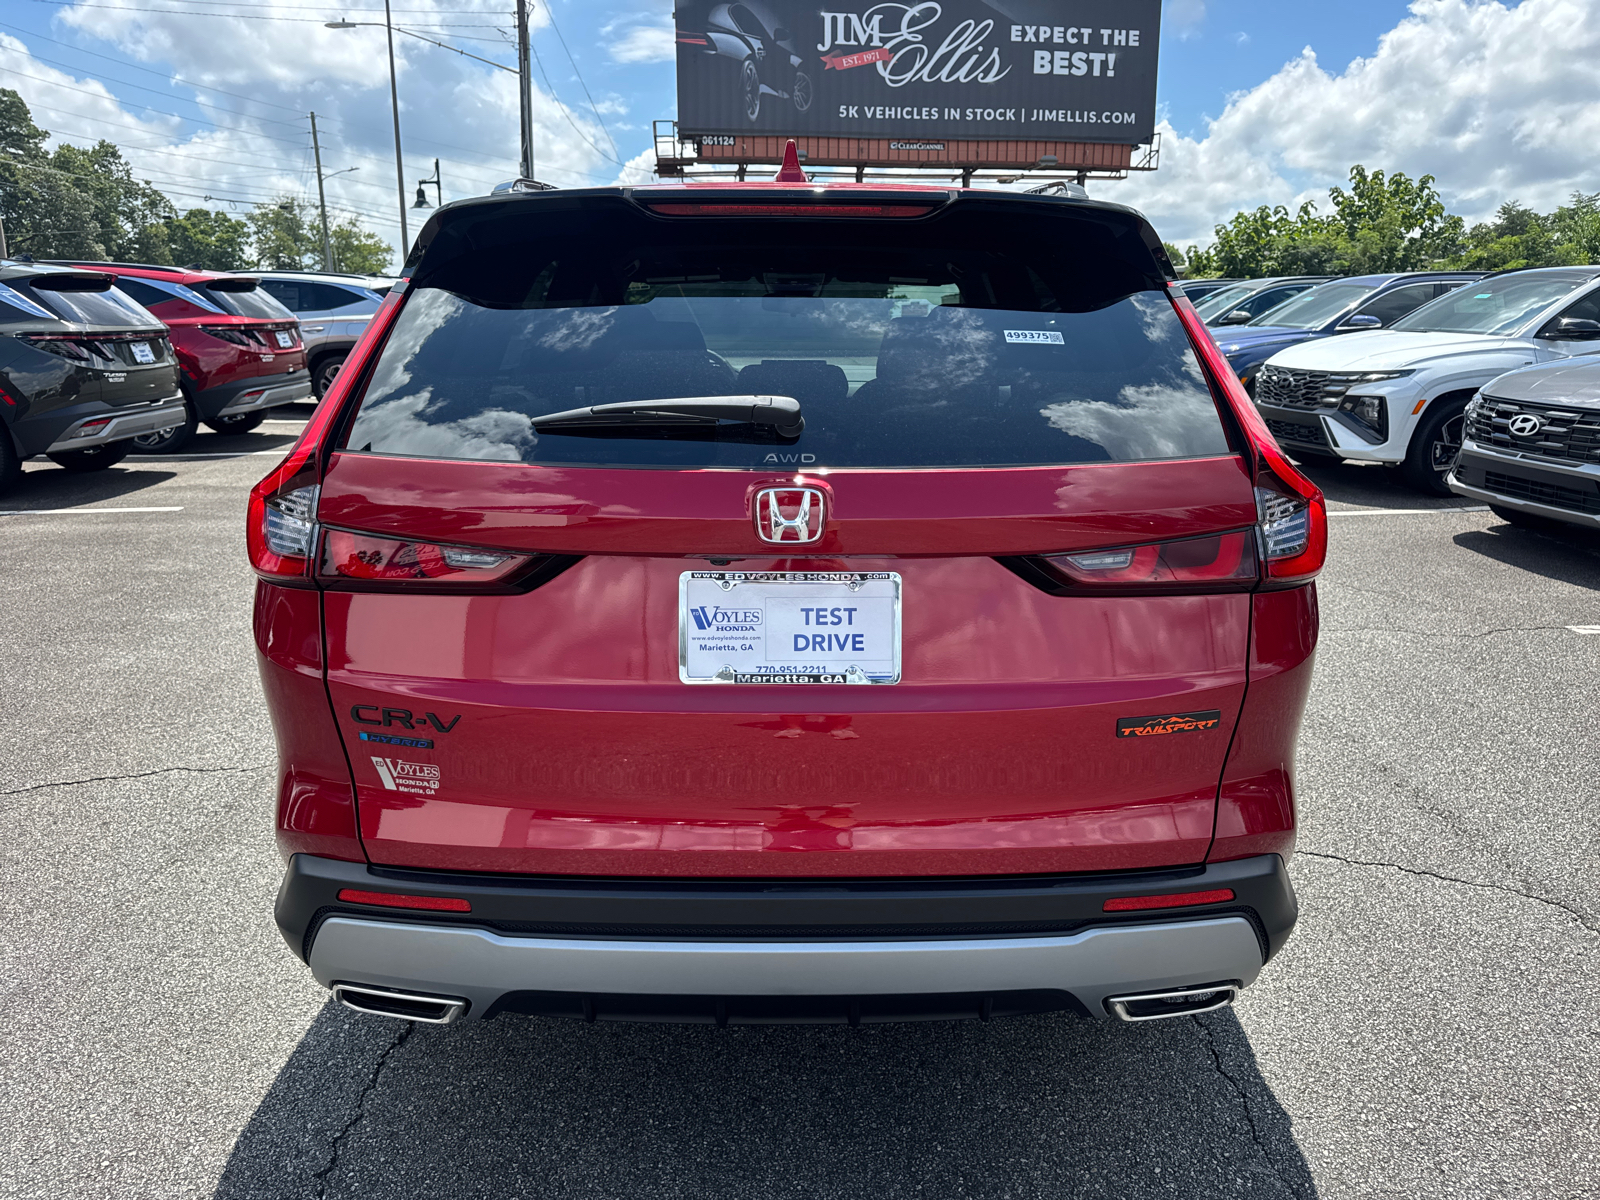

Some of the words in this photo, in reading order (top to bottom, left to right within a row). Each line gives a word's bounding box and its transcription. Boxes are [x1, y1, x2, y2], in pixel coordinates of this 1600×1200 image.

[1010, 24, 1092, 44] EXPECT
[1100, 28, 1140, 46] THE
[817, 12, 883, 51] JIM
[862, 2, 1012, 87] Ellis
[842, 56, 862, 67] EST.
[863, 52, 880, 63] 1971
[1033, 49, 1116, 77] BEST!
[839, 105, 859, 118] 5K
[864, 106, 939, 120] VEHICLES
[944, 107, 961, 120] IN
[965, 108, 1016, 121] STOCK
[1031, 108, 1136, 125] JIMELLIS.COM
[702, 136, 735, 146] 061124
[1006, 331, 1050, 340] 499375
[763, 453, 816, 463] AWD
[800, 607, 858, 626] TEST
[699, 643, 738, 652] Marietta,
[740, 643, 754, 651] GA
[793, 633, 865, 652] DRIVE
[736, 674, 814, 683] Marietta,
[820, 674, 845, 683] GA
[350, 704, 462, 733] CR-V
[1121, 719, 1218, 736] TRAILSPORT
[369, 734, 428, 748] HYBRID
[384, 758, 439, 778] VOYLES
[395, 778, 430, 787] HONDA
[398, 785, 425, 795] Marietta,
